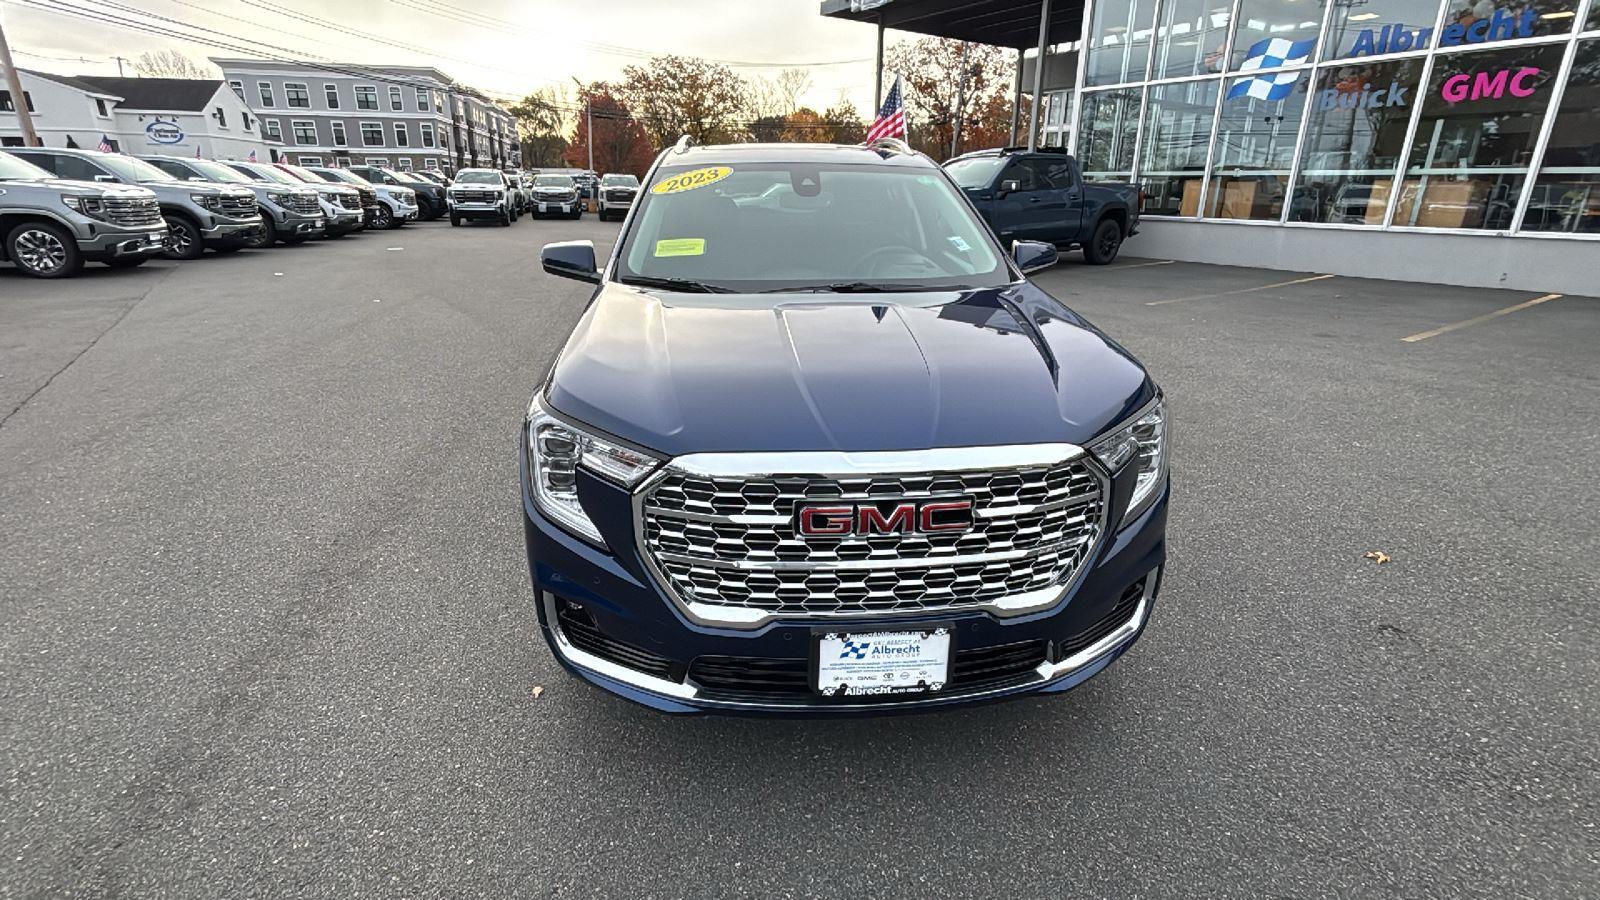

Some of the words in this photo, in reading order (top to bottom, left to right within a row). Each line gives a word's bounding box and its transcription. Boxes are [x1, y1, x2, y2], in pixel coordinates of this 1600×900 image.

[1349, 8, 1539, 58] Albrecht
[1319, 82, 1409, 111] Buick
[1441, 66, 1541, 103] GMC
[667, 169, 719, 192] 2023
[799, 501, 972, 536] GMC
[871, 645, 921, 654] Albrecht
[844, 685, 892, 696] Albrecht
